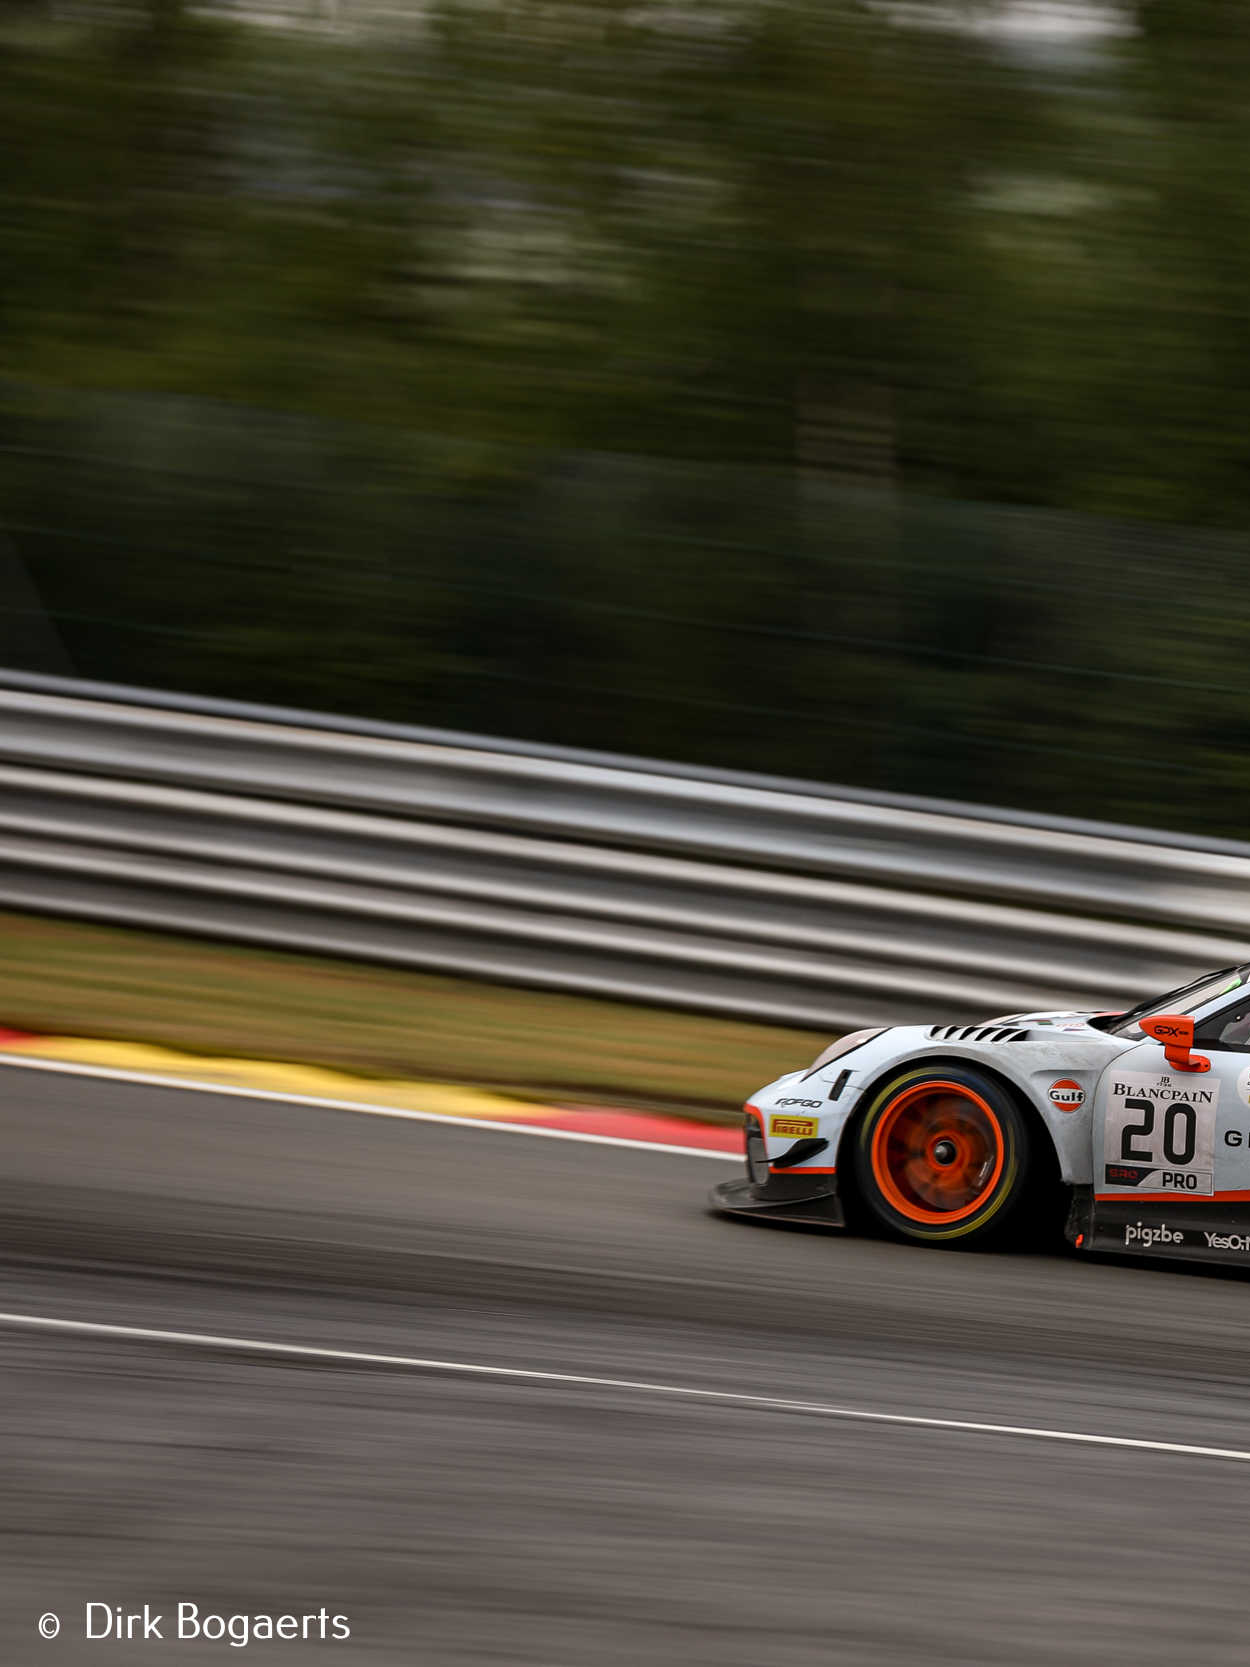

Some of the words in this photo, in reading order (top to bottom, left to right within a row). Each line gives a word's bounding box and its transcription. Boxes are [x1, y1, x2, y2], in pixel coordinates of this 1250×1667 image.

[1050, 1090, 1084, 1101] Gulf
[1113, 1083, 1214, 1103] BLANCPAIN
[772, 1119, 814, 1136] PIRELLI
[1121, 1098, 1197, 1165] 20
[1162, 1171, 1197, 1189] PRO
[1125, 1221, 1184, 1247] pigzbe
